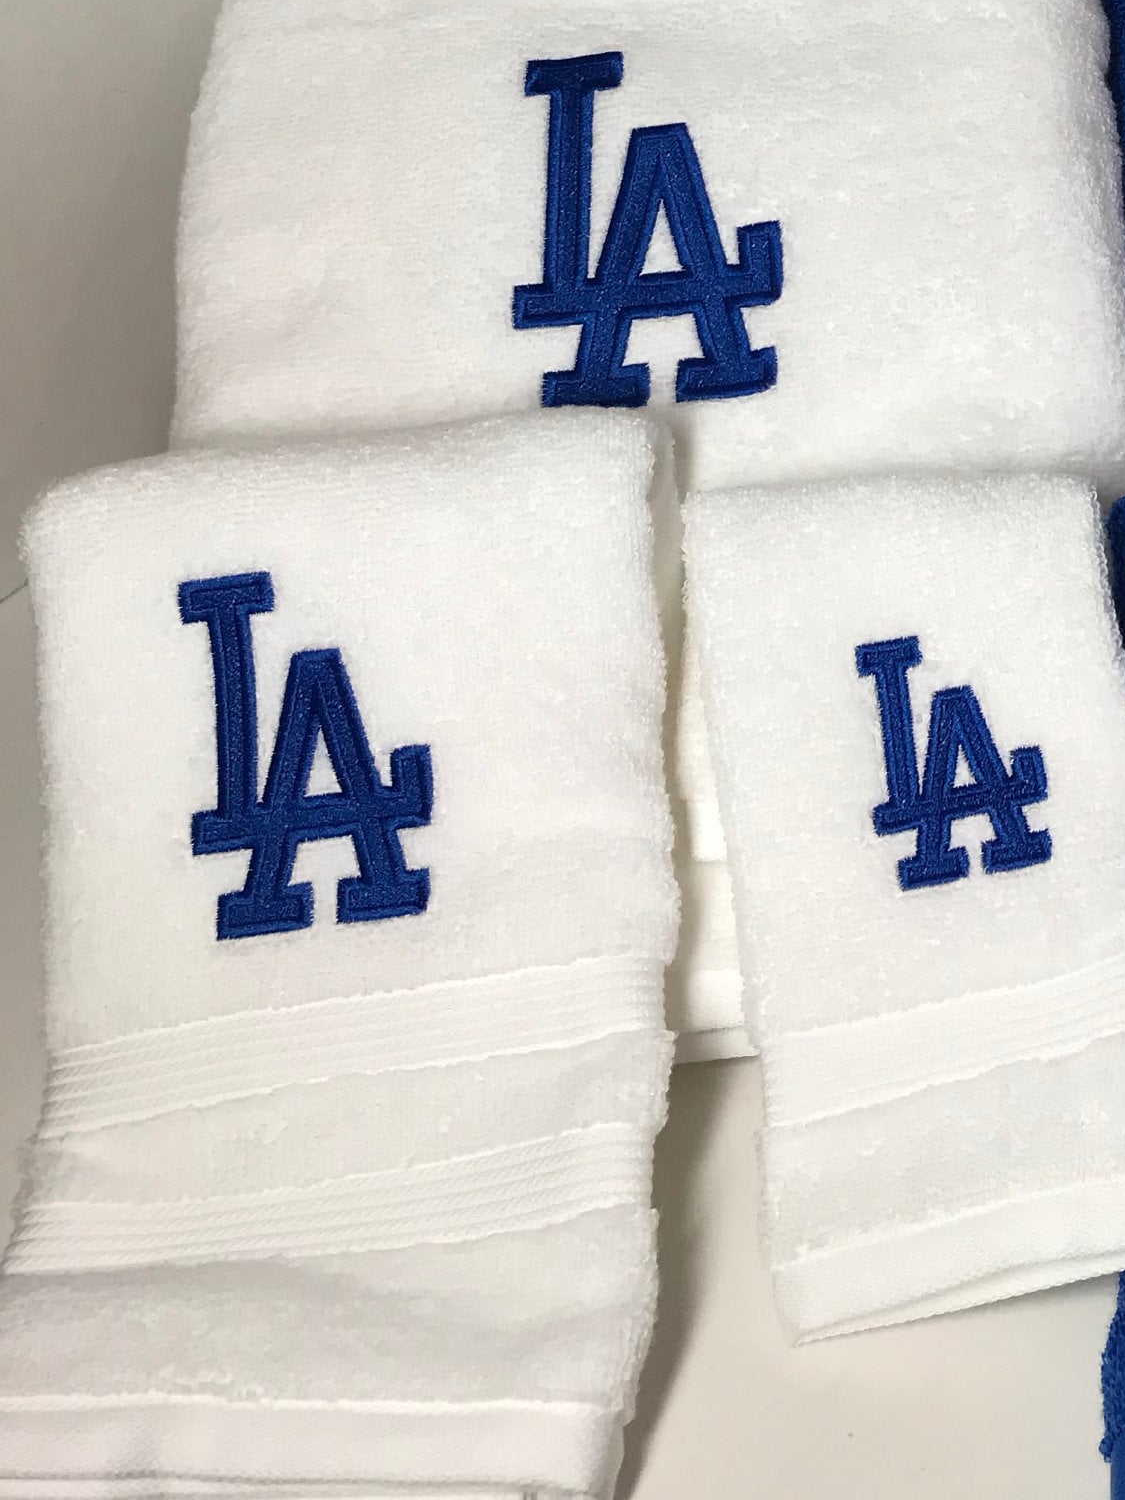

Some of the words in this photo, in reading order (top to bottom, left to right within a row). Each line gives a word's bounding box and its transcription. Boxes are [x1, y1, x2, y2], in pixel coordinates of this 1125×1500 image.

[514, 54, 782, 406] LA
[180, 573, 432, 938] LA
[857, 637, 1051, 887] LA
